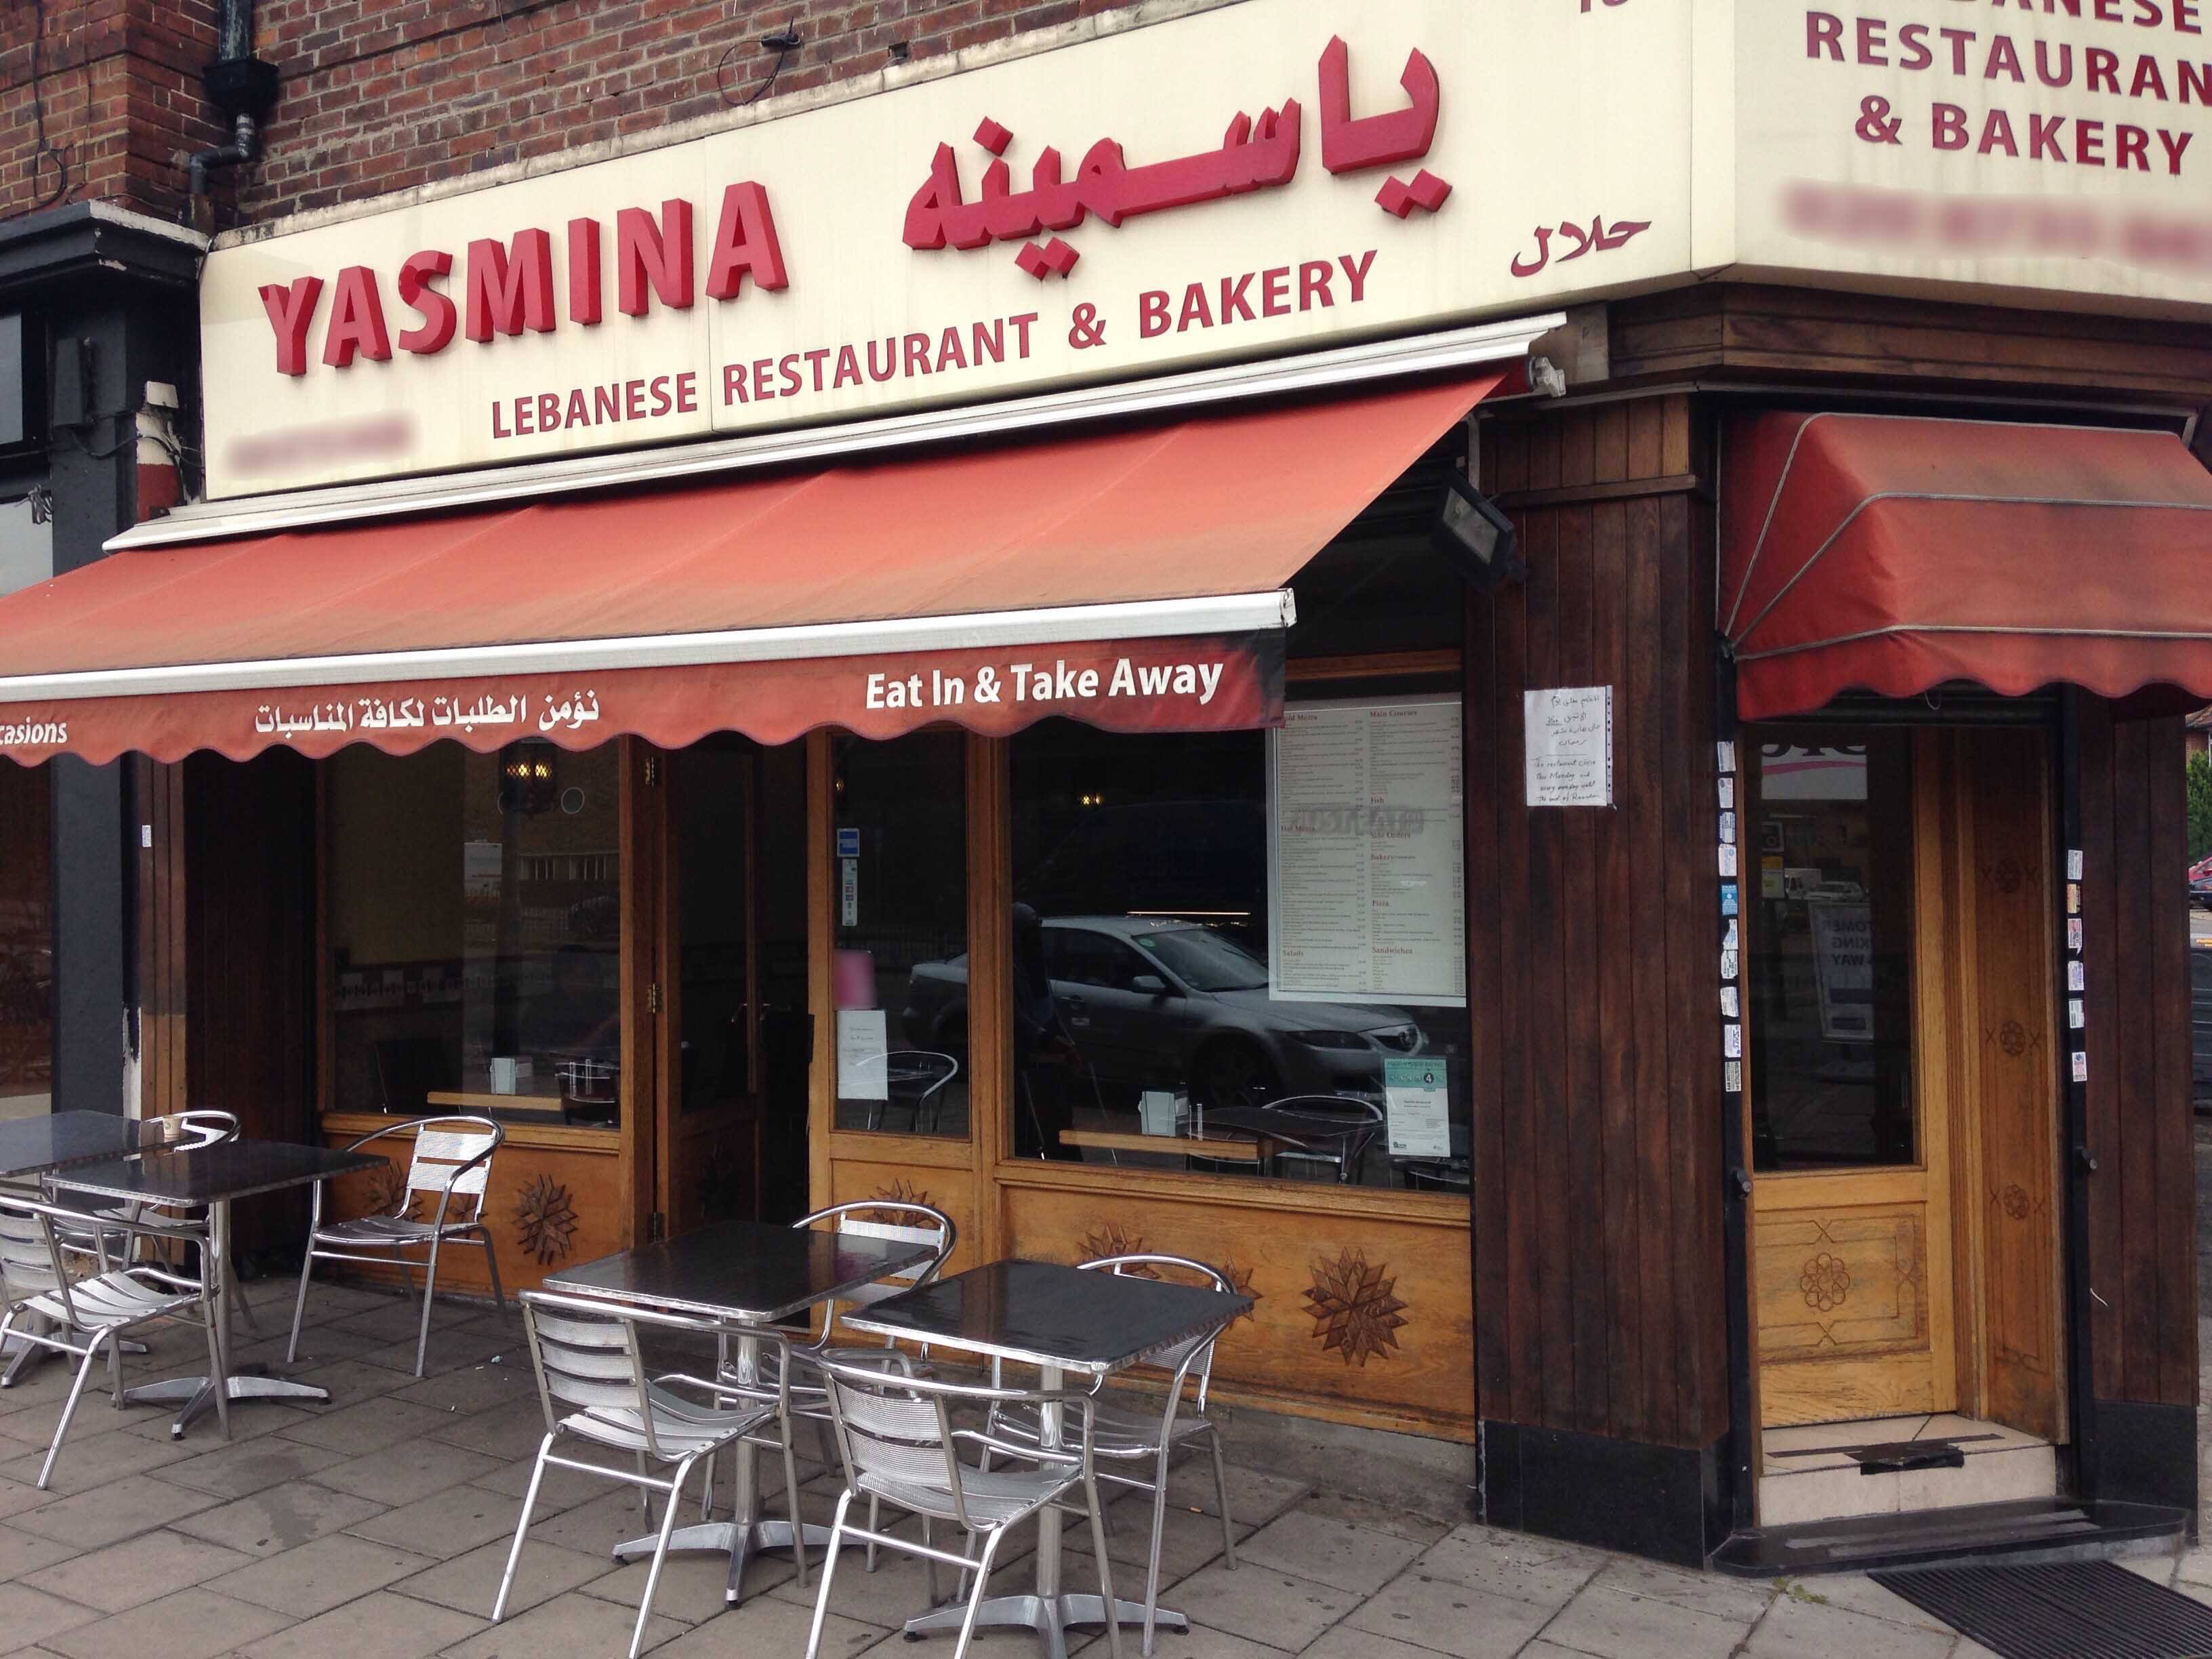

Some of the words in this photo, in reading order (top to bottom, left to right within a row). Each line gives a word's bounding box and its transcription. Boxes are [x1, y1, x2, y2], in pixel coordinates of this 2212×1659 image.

[1855, 95, 1902, 145] &
[1931, 103, 2193, 176] BAKERY
[1511, 215, 1652, 276] حلال
[258, 181, 789, 376] YASMINA
[493, 372, 698, 439] LEBANESE
[724, 312, 1038, 405] RESTAURANT
[1069, 303, 1107, 350] &
[1139, 249, 1378, 338] BAKERY
[866, 673, 923, 709] Eat
[933, 670, 966, 705] In
[974, 666, 1002, 703] &
[1010, 660, 1099, 701] Take
[1108, 657, 1224, 706] Away
[255, 702, 352, 739] المناسبات
[432, 695, 527, 733] الطلبات
